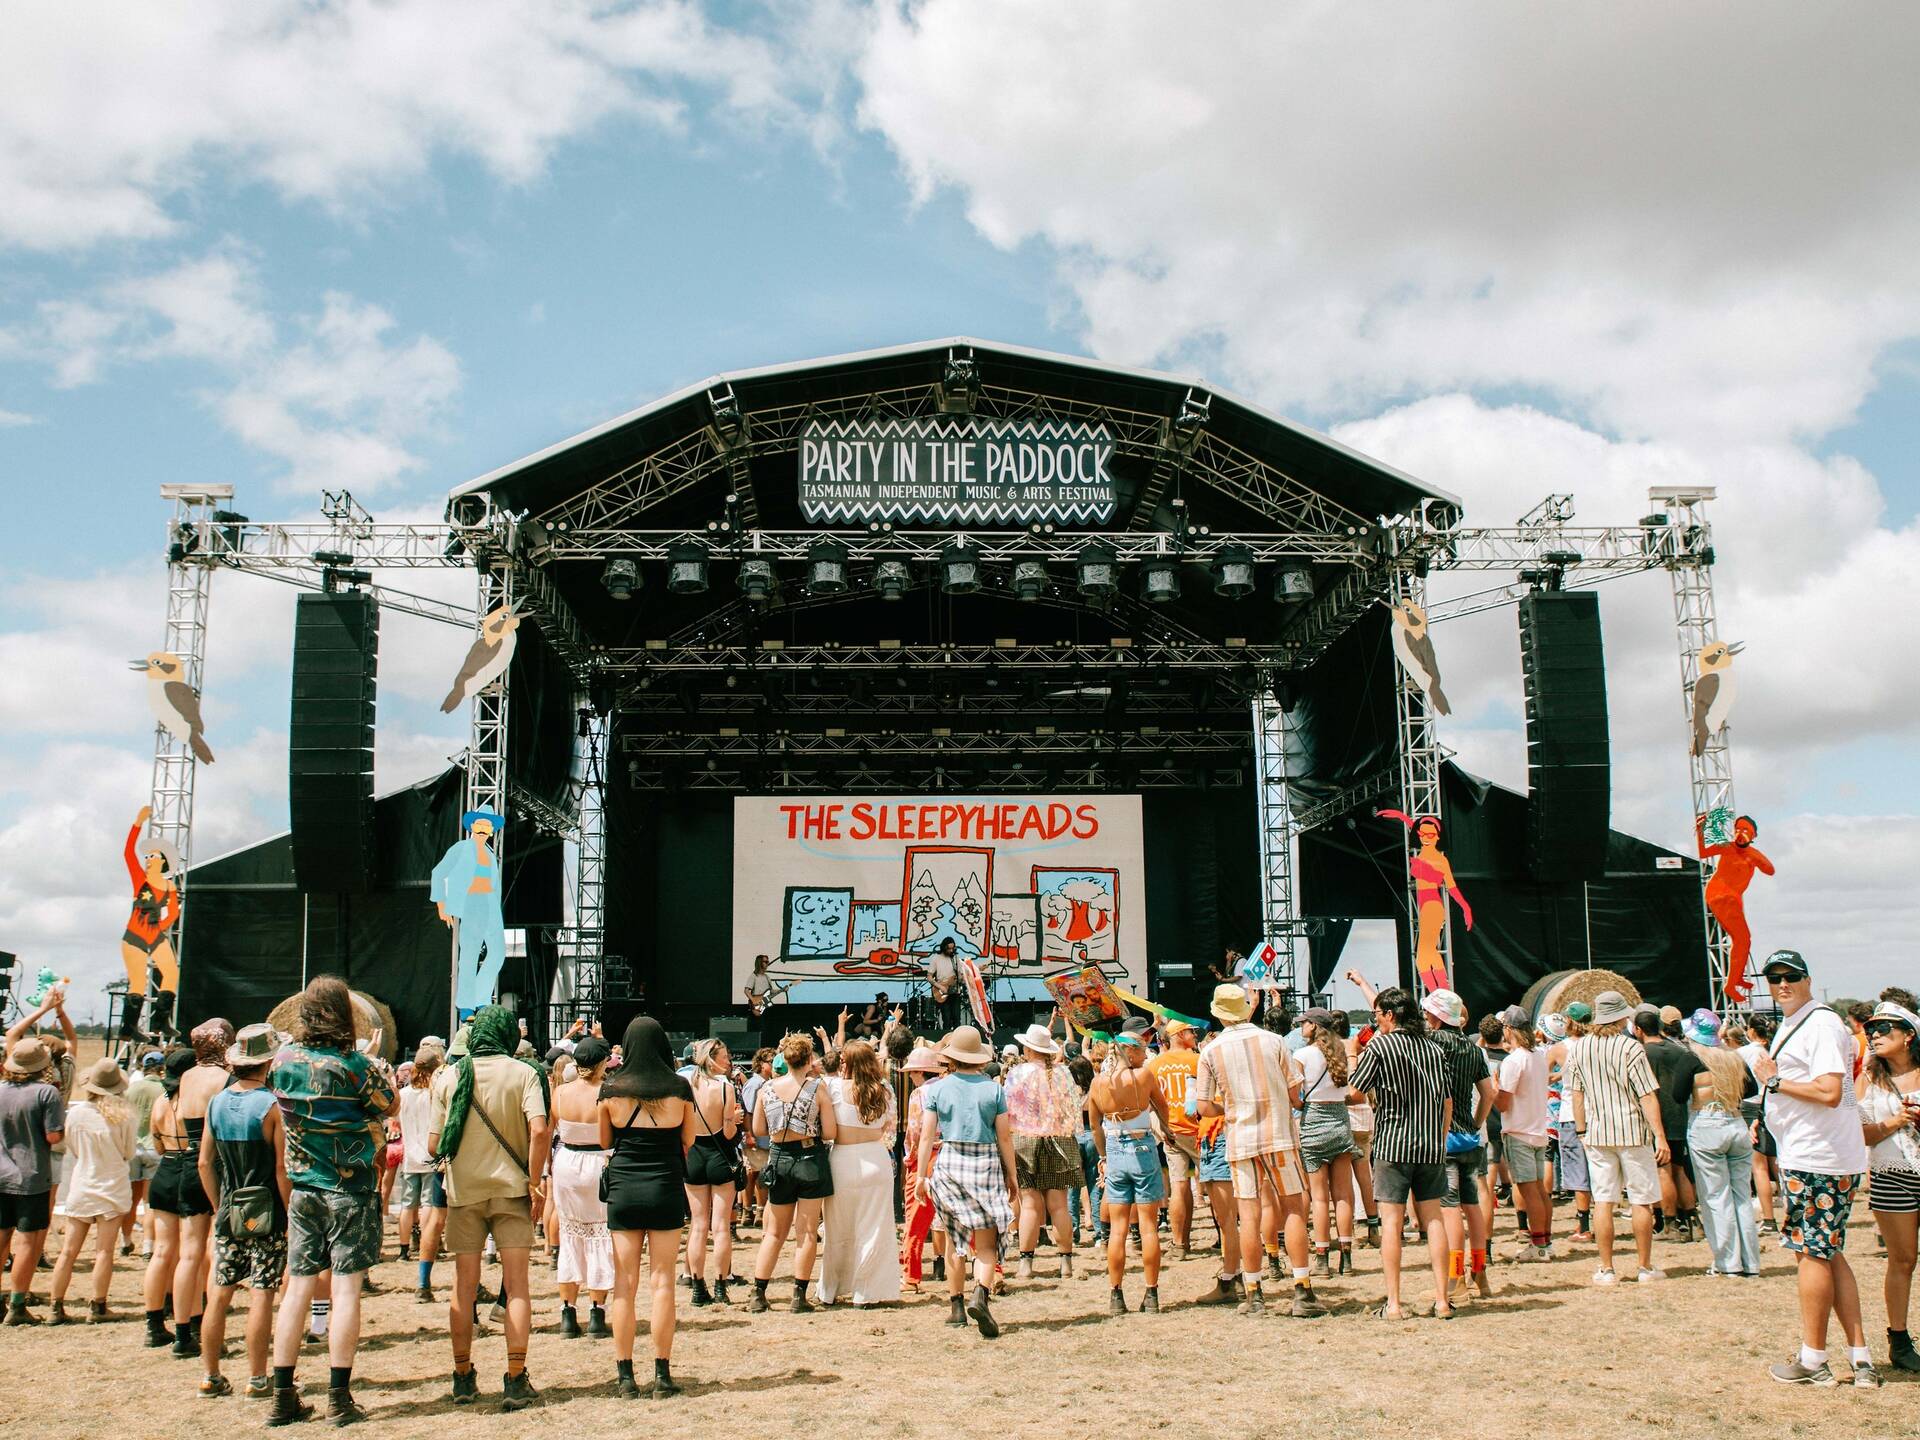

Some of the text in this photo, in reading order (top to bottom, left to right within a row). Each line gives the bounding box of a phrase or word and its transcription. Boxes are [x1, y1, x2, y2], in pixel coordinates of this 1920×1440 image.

[802, 440, 1112, 484] PARTY IN THE PADDOCK
[802, 484, 1113, 501] TASMANIAN INDEPENDENT MUSIC & ARTS FESTIVAL
[779, 802, 1100, 841] THE SLEEPYHEADS
